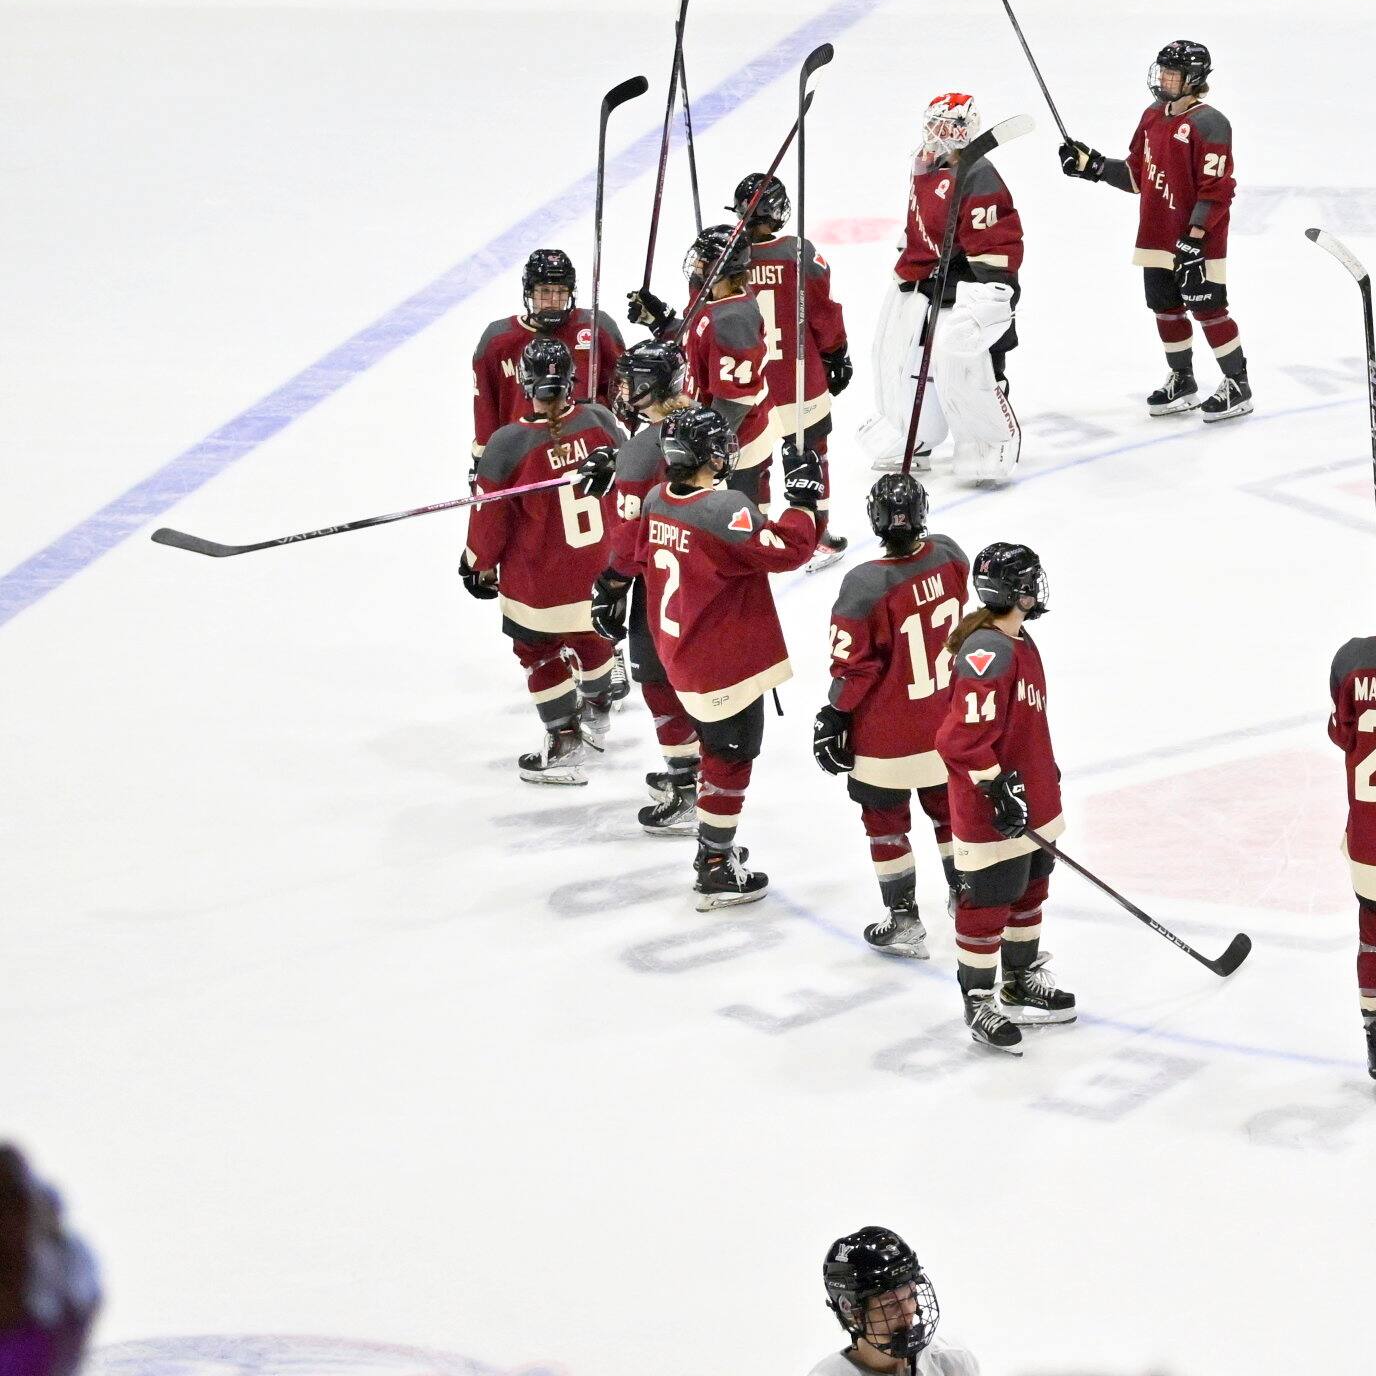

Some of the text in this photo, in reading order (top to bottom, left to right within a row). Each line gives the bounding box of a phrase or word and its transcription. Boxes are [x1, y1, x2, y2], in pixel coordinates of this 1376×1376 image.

[970, 204, 999, 230] 20
[719, 355, 753, 384] 24
[994, 385, 1016, 438] VAUGHN
[558, 470, 605, 549] 6
[649, 519, 692, 553] EOPPLE
[653, 548, 681, 639] 2
[911, 572, 946, 607] LUM
[899, 597, 960, 701] 12
[963, 689, 997, 725] 14
